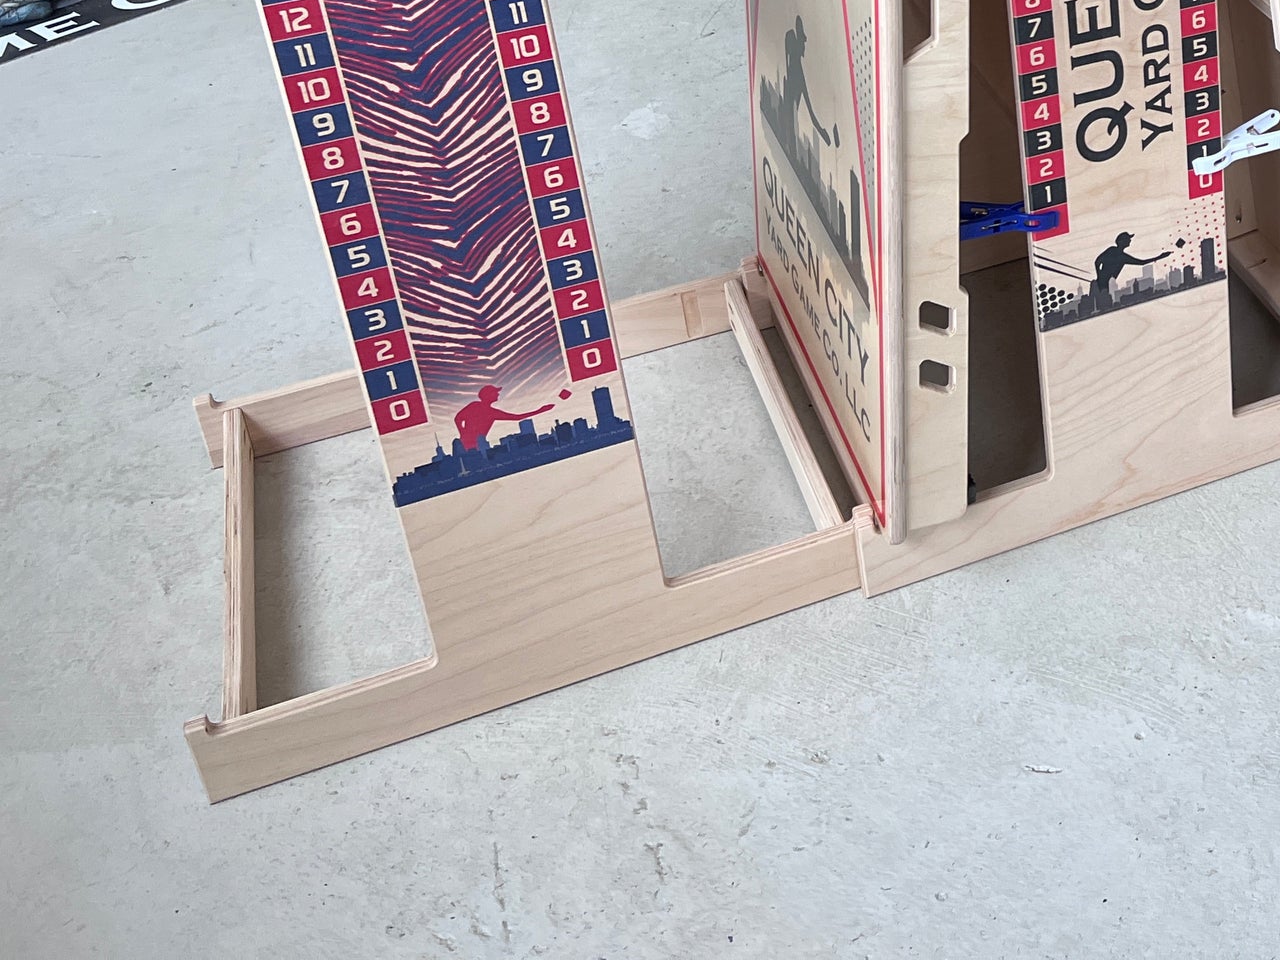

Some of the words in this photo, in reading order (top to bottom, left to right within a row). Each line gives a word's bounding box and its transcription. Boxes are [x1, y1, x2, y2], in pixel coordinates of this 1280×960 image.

[279, 7, 312, 33] 12
[510, 35, 540, 59] 10
[1030, 46, 1045, 66] 6
[1193, 37, 1207, 57] 5
[297, 78, 330, 103] 10
[1141, 23, 1174, 151] YARD
[1034, 103, 1050, 120] 4
[1196, 92, 1209, 110] 3
[530, 102, 550, 124] 8
[1198, 119, 1210, 137] 2
[322, 147, 344, 169] 8
[1040, 158, 1053, 177] 2
[544, 166, 563, 188] 6
[1045, 185, 1051, 203] 1
[340, 214, 361, 235] 6
[557, 228, 577, 248] 4
[762, 156, 821, 295] QUEEN
[824, 277, 869, 386] CITY
[357, 278, 379, 297] 4
[570, 289, 589, 310] 2
[764, 207, 789, 273] YARD
[791, 267, 822, 340] GAME
[845, 374, 871, 443] LLC
[374, 340, 394, 361] 2
[582, 348, 601, 368] 0
[389, 400, 410, 421] 0
